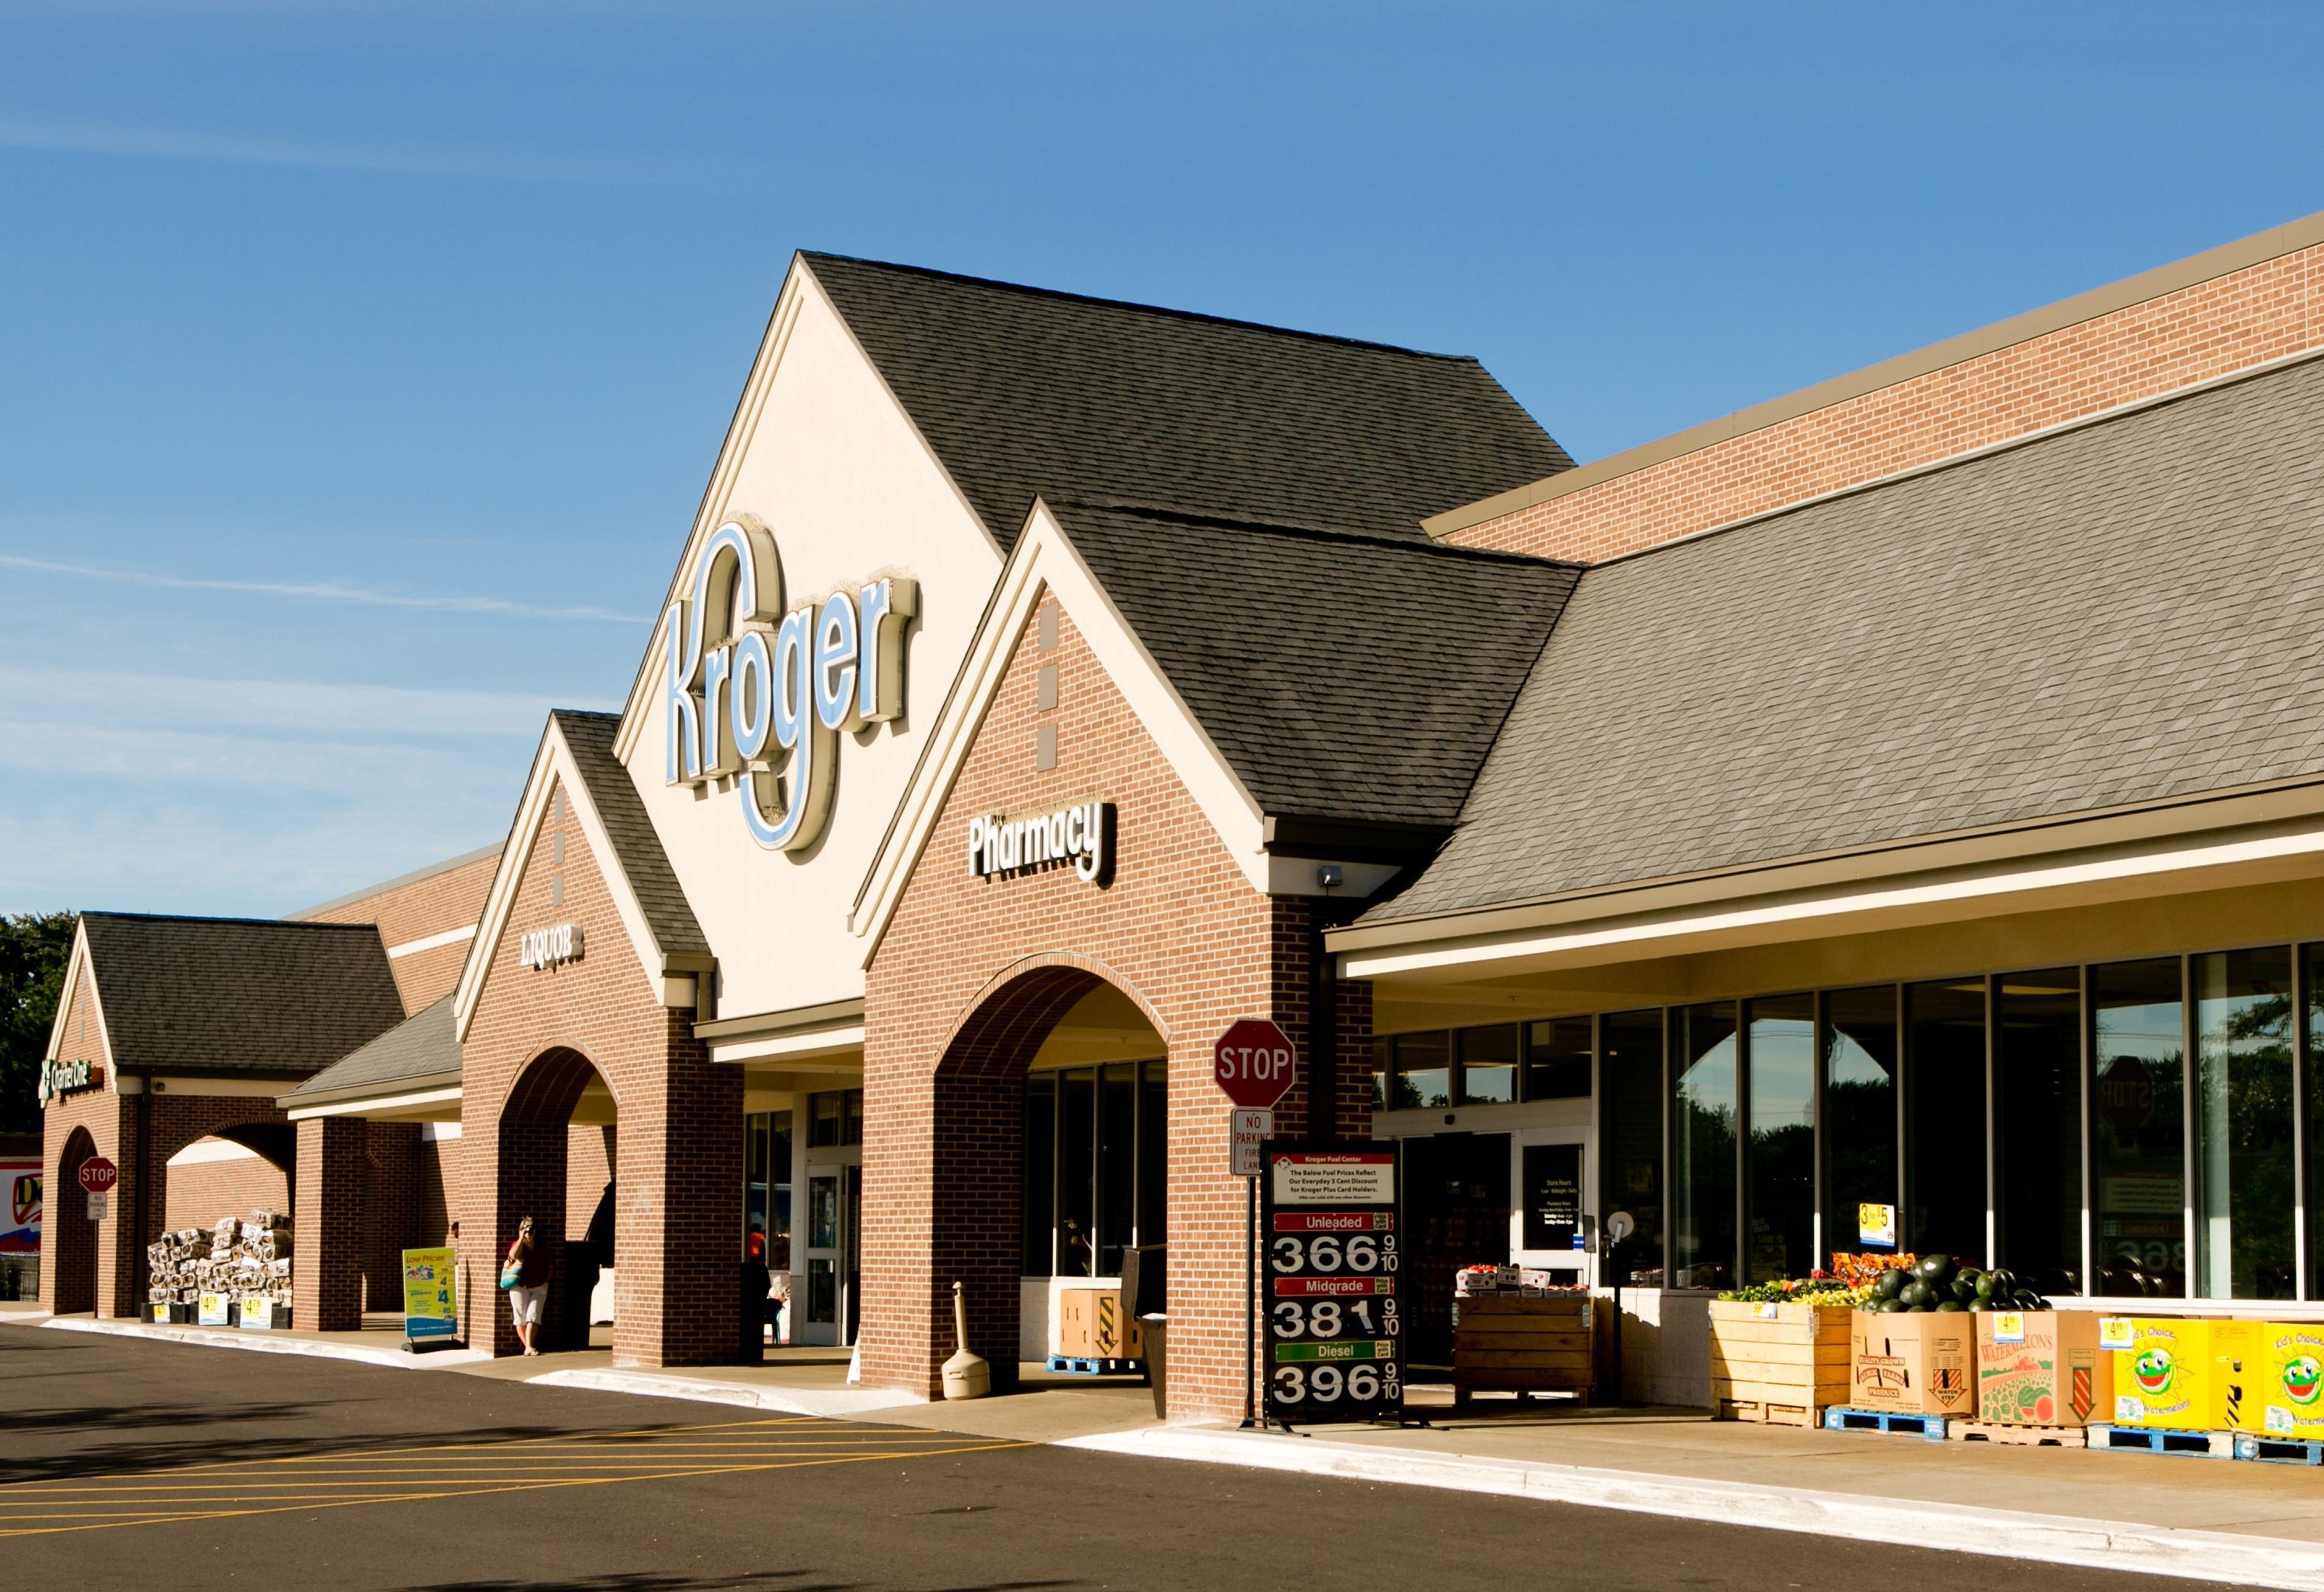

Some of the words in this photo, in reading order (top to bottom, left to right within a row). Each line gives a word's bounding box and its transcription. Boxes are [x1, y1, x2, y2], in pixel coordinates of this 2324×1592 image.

[666, 520, 896, 852] Kroger
[968, 802, 1103, 882] Pharmacy
[520, 924, 573, 970] LIQUOR
[1219, 1047, 1289, 1080] STOP
[1247, 1116, 1261, 1128] NO
[1236, 1132, 1271, 1144] PARKING
[82, 1168, 115, 1182] STOP
[1861, 1205, 1868, 1224] 3
[1306, 1216, 1362, 1228] Unleaded
[421, 1255, 444, 1263] Prices
[1272, 1236, 1378, 1273] 366
[1306, 1281, 1364, 1295] Midgrade
[2148, 1326, 2175, 1338] Choice
[2296, 1333, 2323, 1345] Choice
[1318, 1345, 1354, 1357] Diesel
[1880, 1357, 1905, 1365] GROWN
[1273, 1365, 1379, 1404] 396
[1868, 1388, 1900, 1398] PRODUCE
